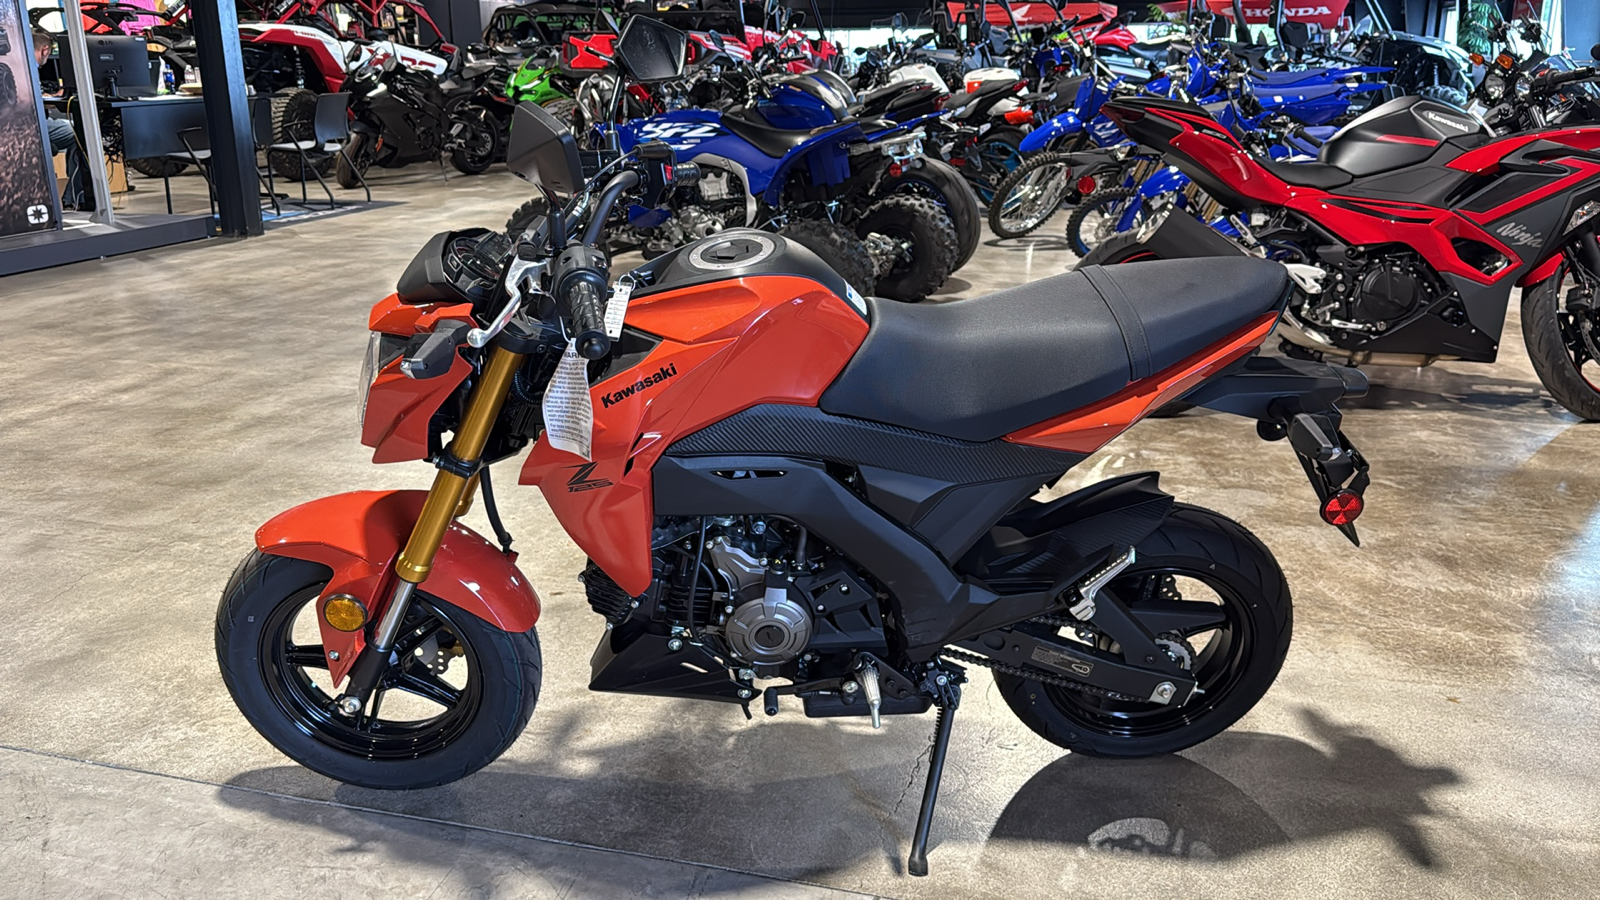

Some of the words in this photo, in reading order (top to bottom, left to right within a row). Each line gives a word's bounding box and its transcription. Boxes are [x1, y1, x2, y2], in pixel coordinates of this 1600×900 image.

[1244, 6, 1332, 17] HONDA
[1428, 111, 1469, 133] Kawasaki
[1496, 221, 1543, 248] Ninja
[601, 362, 677, 408] Kawasaki
[561, 461, 609, 487] Z
[568, 480, 614, 493] 125
